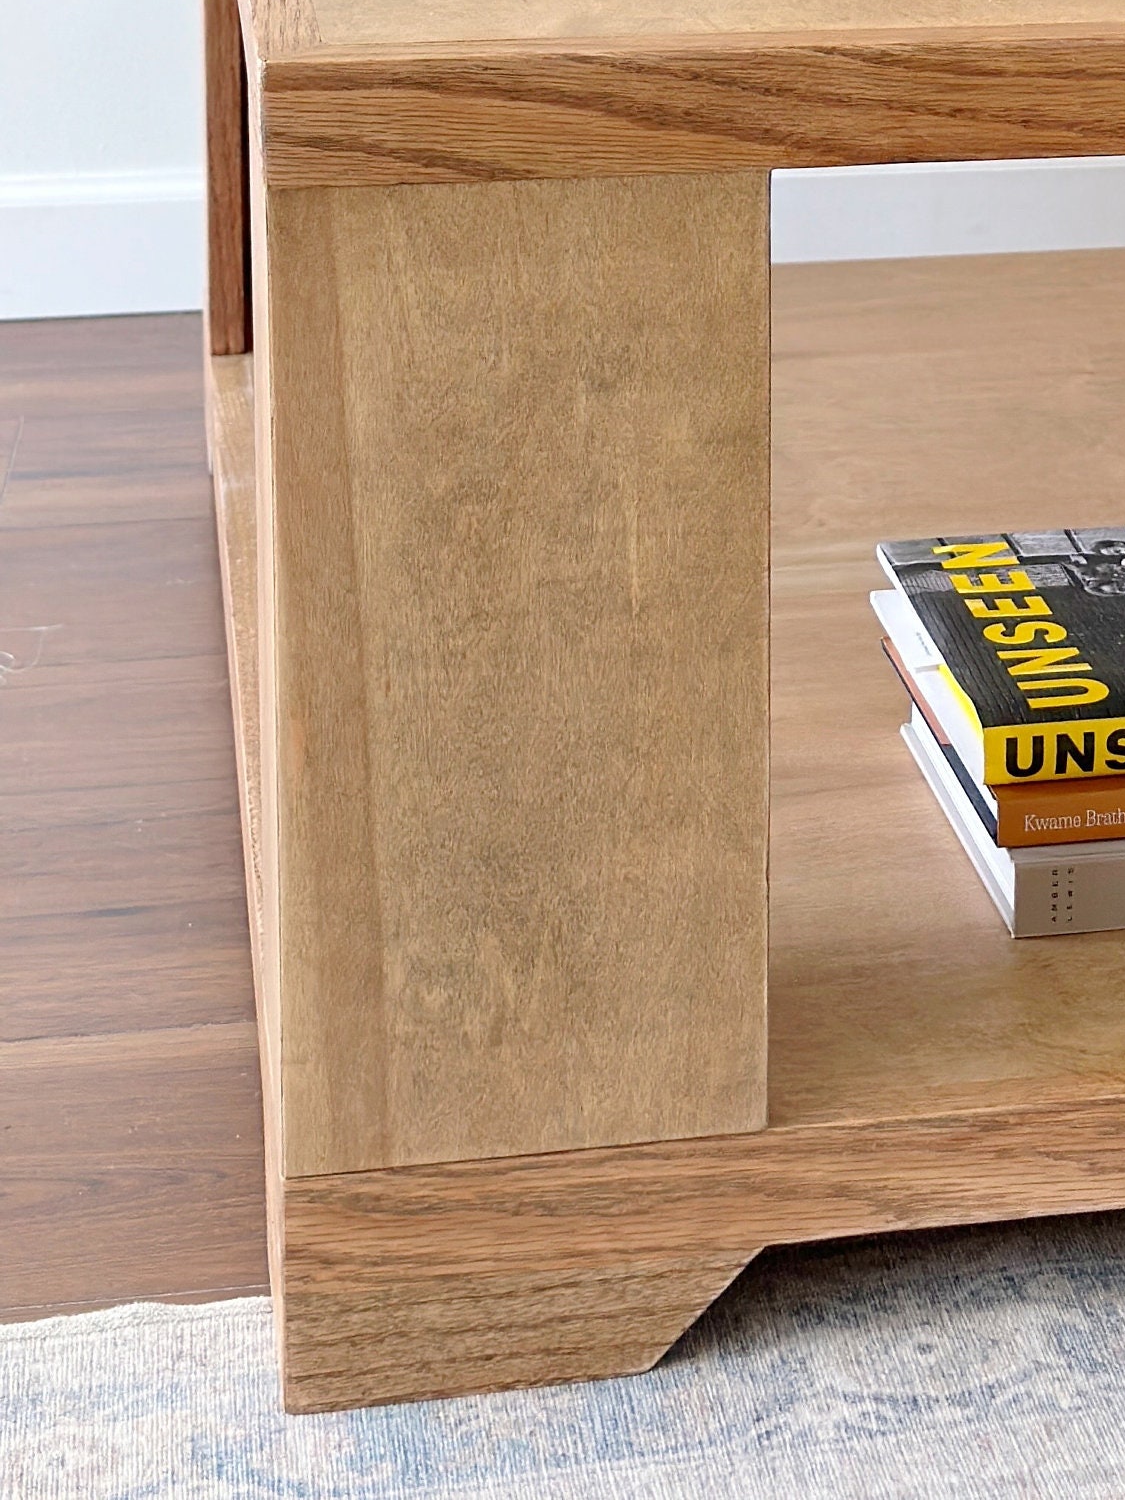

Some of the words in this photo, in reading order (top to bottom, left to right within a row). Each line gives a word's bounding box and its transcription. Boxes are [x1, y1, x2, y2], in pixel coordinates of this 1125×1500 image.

[932, 541, 1110, 709] UNSEEN
[1024, 813, 1082, 832] Kwame
[1050, 868, 1059, 924] AMBER
